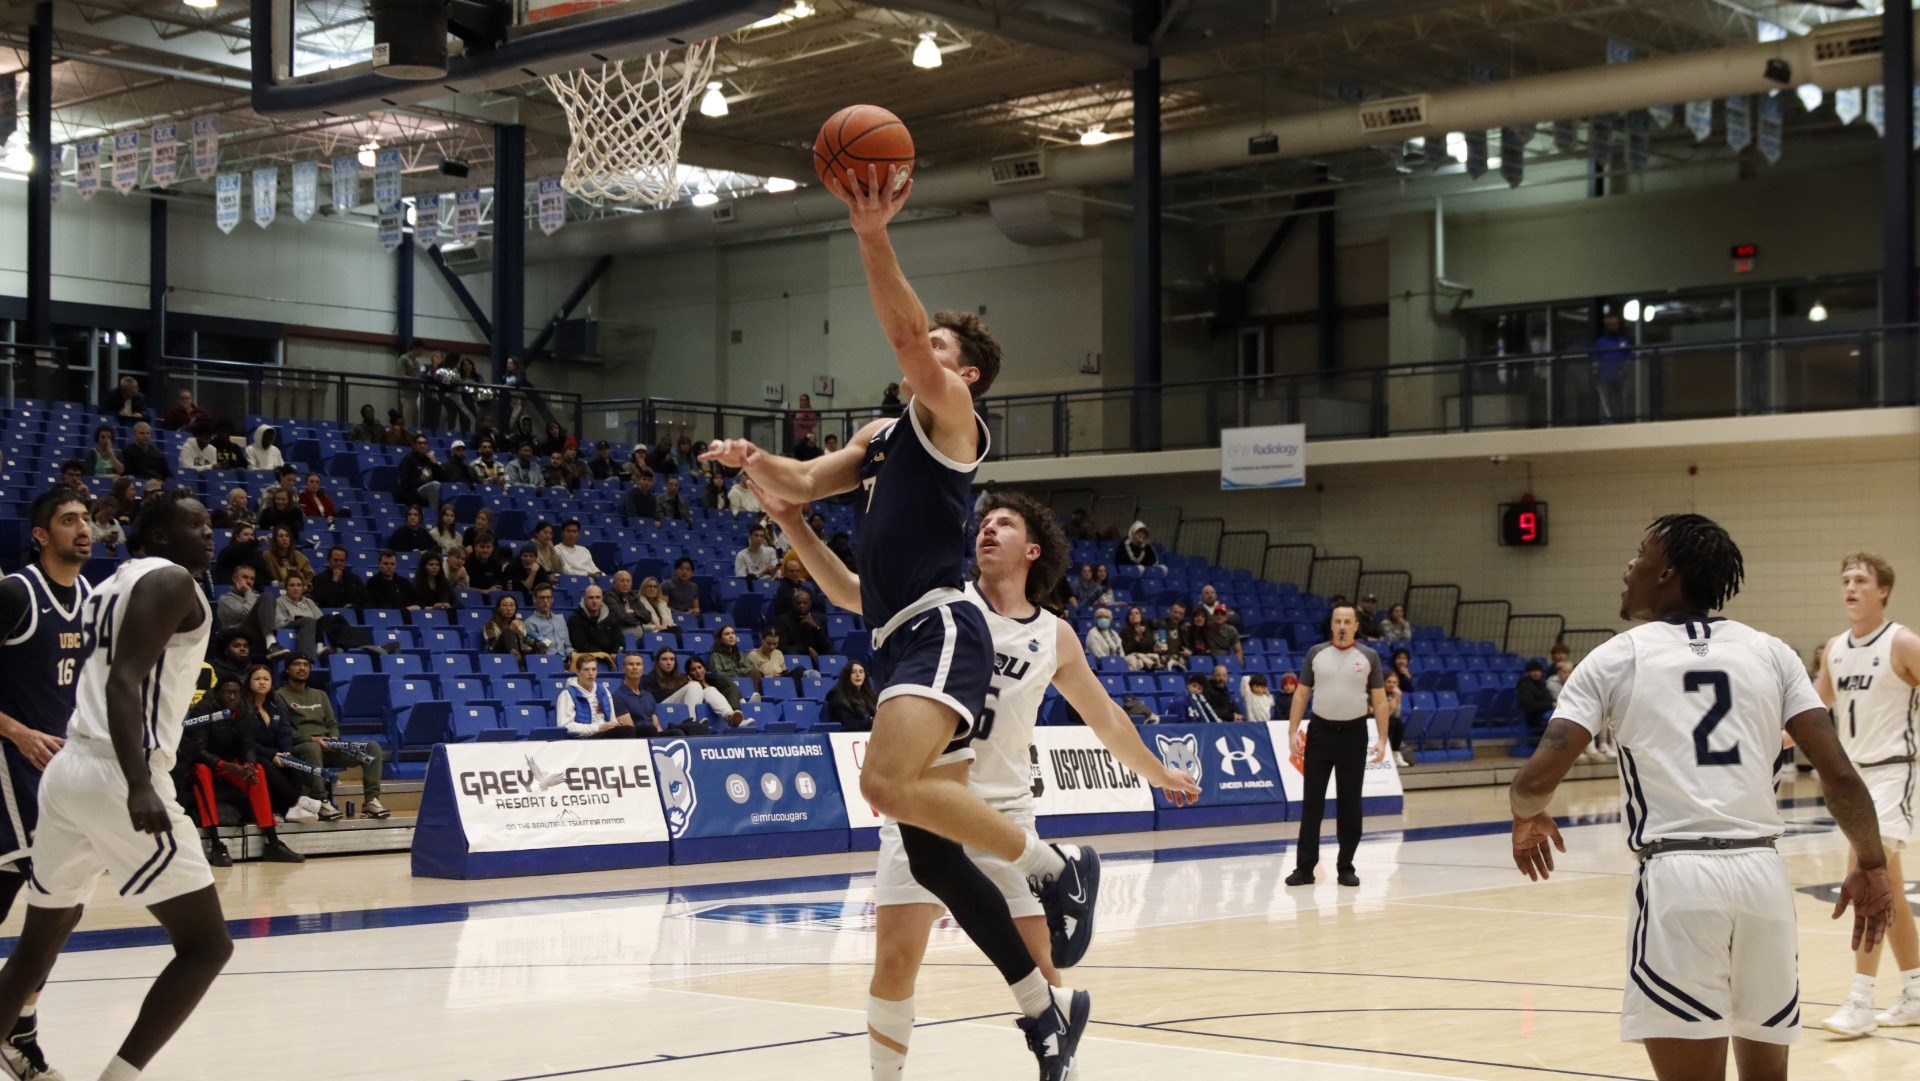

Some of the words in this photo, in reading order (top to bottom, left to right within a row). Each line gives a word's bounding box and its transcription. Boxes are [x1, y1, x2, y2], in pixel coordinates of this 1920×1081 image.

[1253, 443, 1298, 457] Radiology
[862, 476, 877, 514] 7
[1519, 512, 1536, 541] 9
[59, 632, 81, 649] UBC
[57, 658, 76, 686] 16
[993, 651, 1030, 680] RU
[1837, 674, 1873, 692] MRU
[1683, 669, 1742, 766] 2
[1848, 698, 1856, 738] 1
[701, 747, 745, 760] FOLLOW
[747, 746, 769, 758] THE
[770, 744, 823, 758] COUGARS!
[460, 769, 534, 804] GREY
[565, 764, 651, 798] EAGLE
[1219, 781, 1243, 790] UNDER
[496, 796, 546, 810] RESORT
[550, 796, 558, 807] &
[562, 793, 610, 806] CASINO
[518, 822, 531, 830] THE
[532, 820, 567, 829] BEAUTIFUL
[751, 811, 808, 825] @mrucougars
